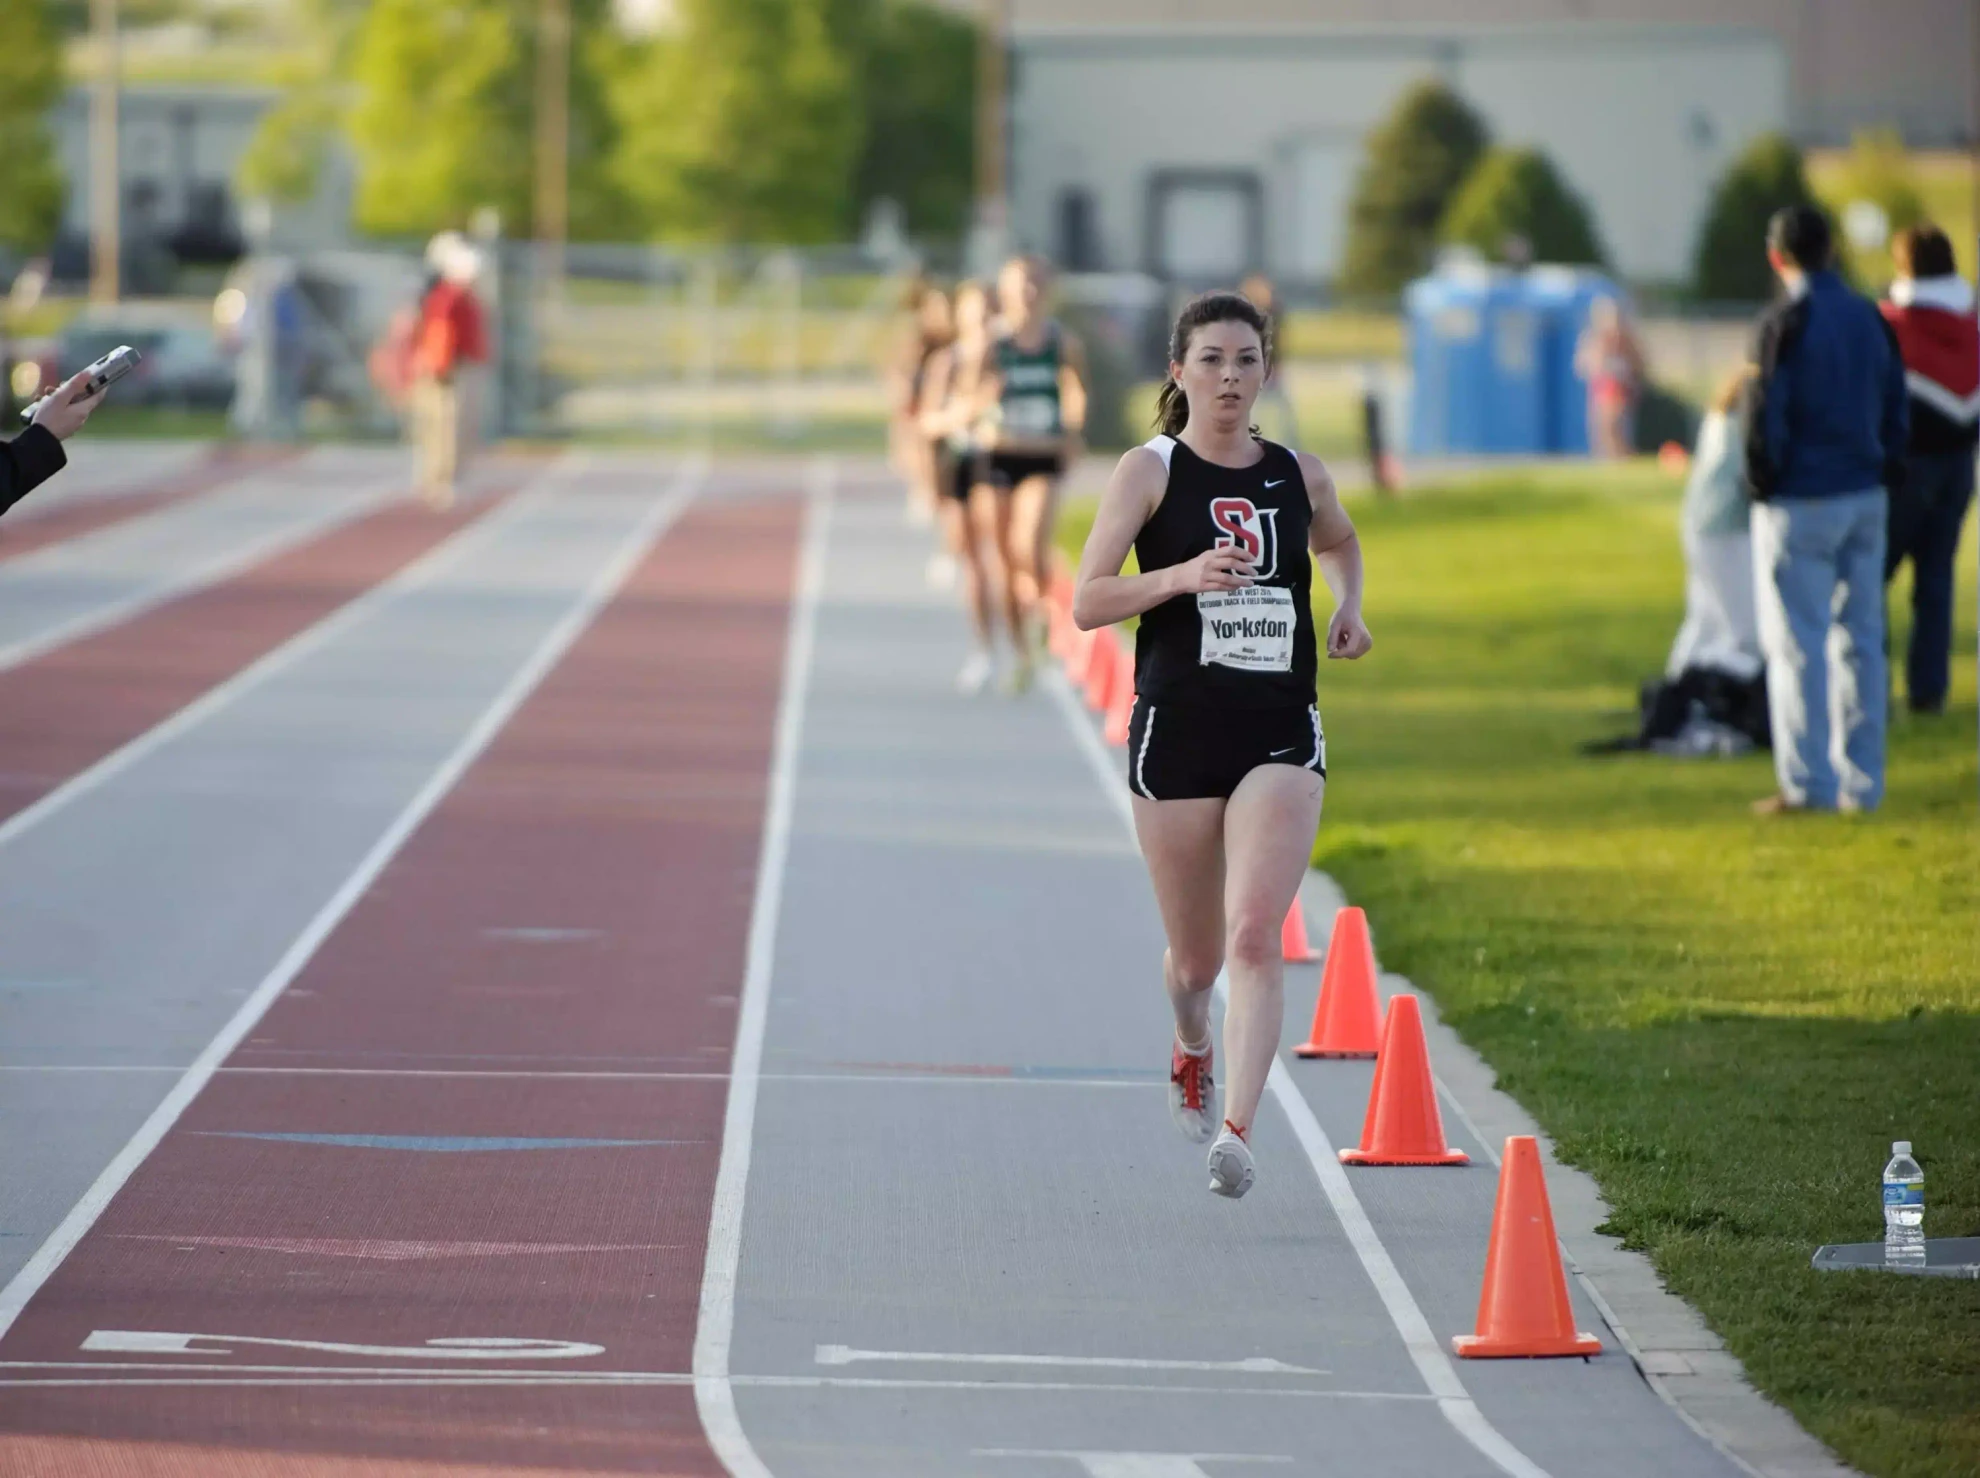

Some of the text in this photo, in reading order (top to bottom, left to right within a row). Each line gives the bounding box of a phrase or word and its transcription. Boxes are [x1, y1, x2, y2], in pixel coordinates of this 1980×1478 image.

[1244, 588, 1259, 596] WEST
[1223, 598, 1240, 607] TRACK
[1241, 597, 1246, 605] &
[1247, 597, 1260, 605] FIELD
[1210, 617, 1287, 639] Yorkston
